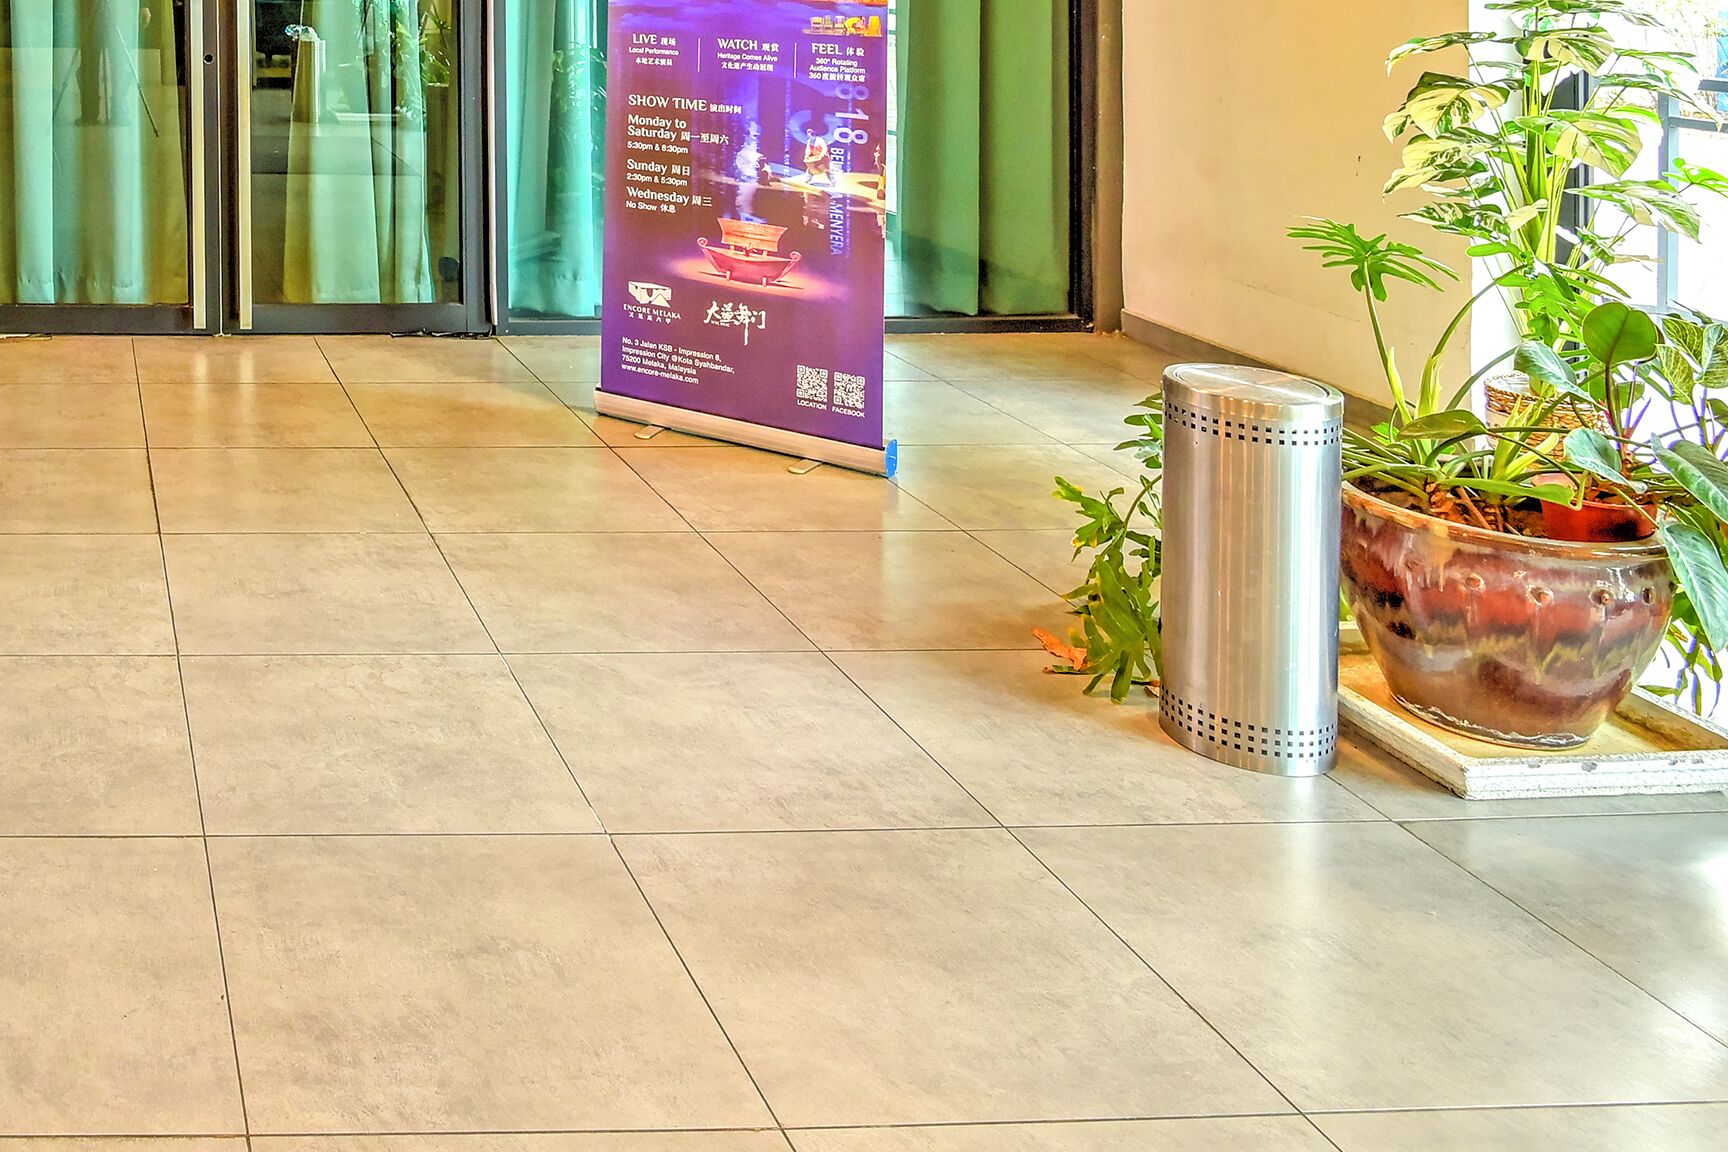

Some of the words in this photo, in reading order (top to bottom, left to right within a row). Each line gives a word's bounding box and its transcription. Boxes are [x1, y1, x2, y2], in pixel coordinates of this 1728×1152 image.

[632, 33, 657, 44] LIVE
[717, 38, 758, 50] WATCH
[645, 47, 679, 56] Performance
[717, 52, 741, 61] Heritage
[742, 53, 762, 61] Comes
[811, 43, 842, 55] FEEL
[832, 58, 858, 67] Rotating
[839, 66, 865, 74] Platform
[628, 94, 669, 108] SHOW
[672, 97, 707, 111] TIME
[627, 114, 672, 129] Monday
[675, 119, 686, 128] to
[627, 125, 677, 141] Saturday
[627, 141, 653, 151] 5:30pm
[654, 143, 660, 151] &
[626, 159, 667, 175] Sunday
[671, 165, 690, 176] 周日
[626, 173, 652, 183] 2:30pm
[653, 175, 659, 183] &
[660, 177, 688, 187] 5:30pm
[626, 186, 689, 206] Wednesday
[691, 195, 712, 207] 周三
[625, 200, 636, 209] No
[637, 202, 658, 211] Show
[623, 303, 651, 315] ENCORE
[652, 309, 681, 320] MELAKA
[622, 337, 633, 345] No.
[640, 340, 657, 350] Jalan
[658, 343, 673, 352] KSB
[678, 347, 714, 360] Impression
[621, 354, 641, 364] 75200
[641, 358, 667, 370] Melaka,
[668, 363, 697, 375] Malaysia
[622, 345, 656, 358] Impression
[656, 352, 670, 362] City
[694, 359, 735, 374] Syahbandar,
[621, 364, 699, 384] www.encore-melaka.com
[797, 399, 827, 410] LOCATION
[832, 406, 865, 418] FACEBOOK
